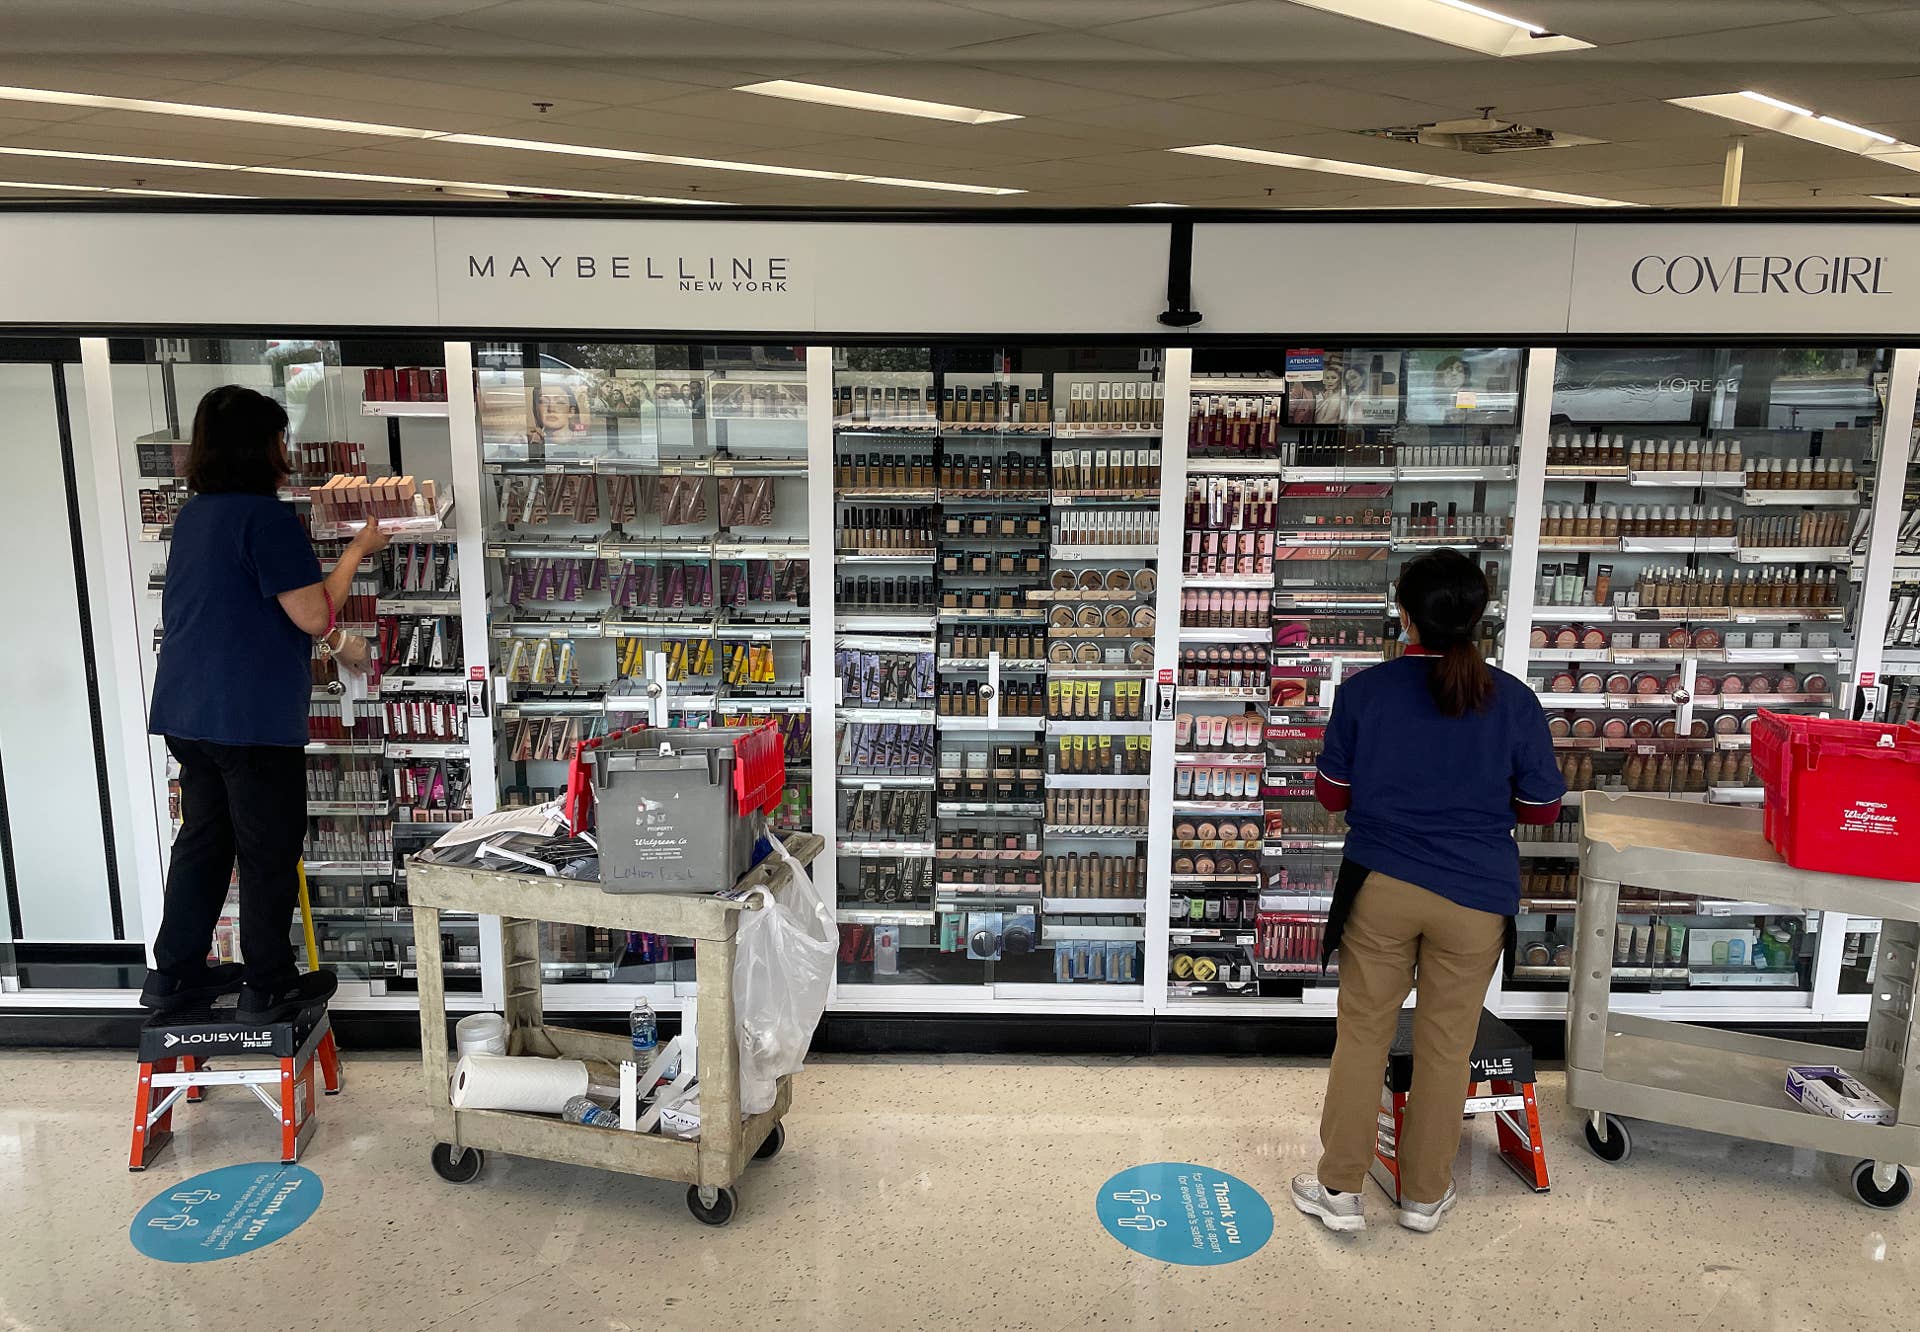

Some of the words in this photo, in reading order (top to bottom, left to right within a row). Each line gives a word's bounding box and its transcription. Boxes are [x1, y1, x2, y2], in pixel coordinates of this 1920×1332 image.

[469, 256, 787, 280] MAYBELLINE
[1631, 255, 1893, 295] COVERGIRL
[680, 282, 723, 292] NEW
[732, 282, 787, 292] YORK
[1844, 810, 1898, 822] Walgreens
[634, 838, 676, 848] Walgreen
[181, 1032, 272, 1044] LOUISVILLE
[1470, 1058, 1513, 1068] VILLE
[1178, 1176, 1188, 1185] for
[1192, 1172, 1202, 1182] for
[262, 1179, 302, 1216] Thank
[1181, 1186, 1198, 1224] everyone's
[1195, 1184, 1208, 1208] staying
[1213, 1182, 1236, 1218] Thank
[242, 1218, 269, 1240] you
[1205, 1216, 1216, 1231] feet
[1220, 1221, 1241, 1244] you
[1191, 1226, 1204, 1250] safety
[1208, 1232, 1222, 1253] apart
